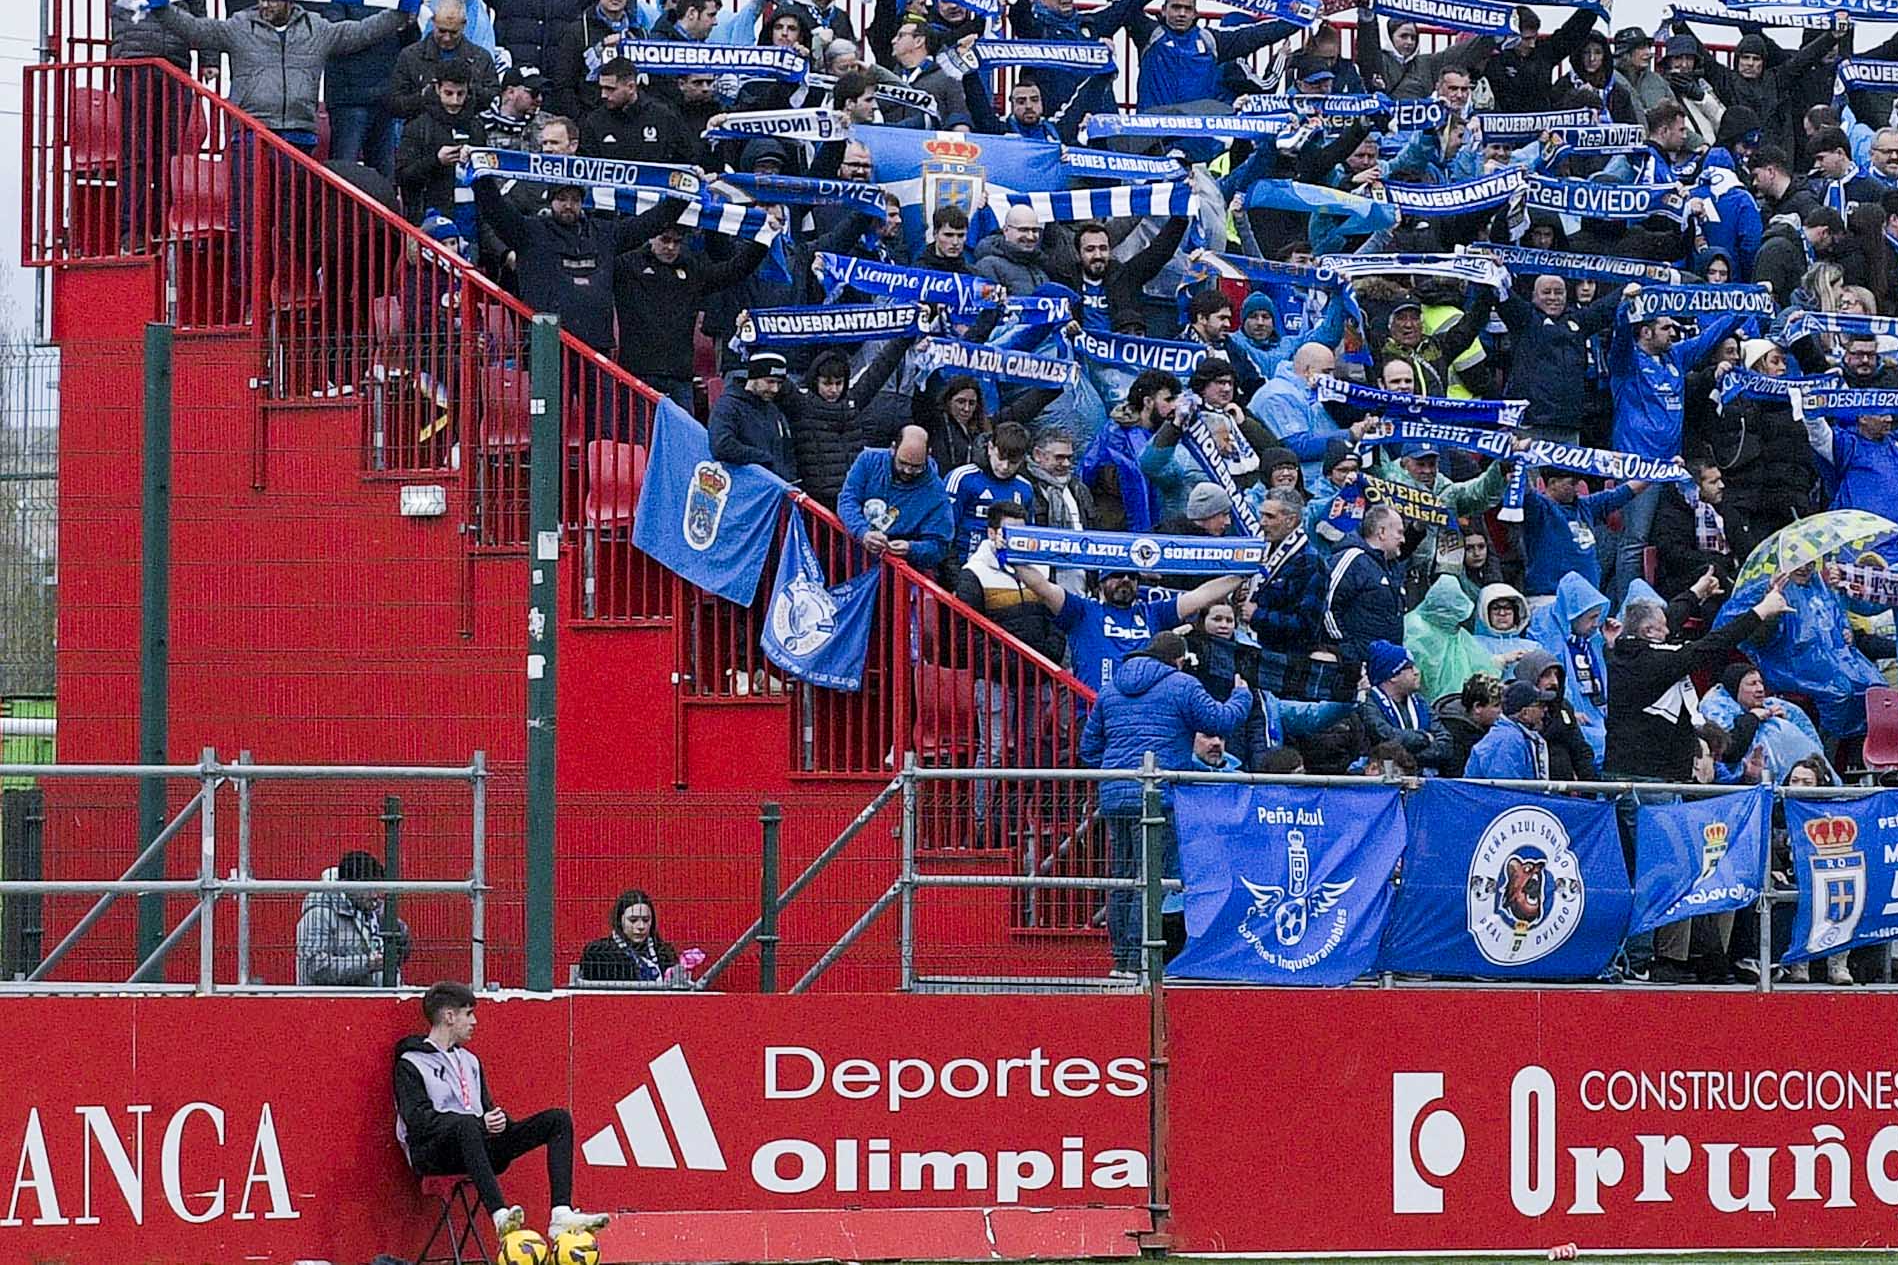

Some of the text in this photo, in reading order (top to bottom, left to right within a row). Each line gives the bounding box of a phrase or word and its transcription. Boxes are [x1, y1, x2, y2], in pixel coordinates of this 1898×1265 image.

[624, 44, 805, 72] INQUEBRANTABLES
[976, 41, 1110, 64] INQUEBRANTABLES
[1121, 116, 1291, 135] CAMPEONES CARBAYONES
[1396, 100, 1442, 125] IEDO
[1483, 110, 1592, 133] INQUEBRANTABLES
[1576, 128, 1606, 147] Real
[529, 152, 639, 185] Real OVIEDO
[1107, 156, 1182, 174] CARBAYONES
[818, 180, 889, 209] OVIED
[1391, 166, 1527, 208] INQUEBRANTABL
[1528, 176, 1651, 213] Real OVIEDO
[1635, 292, 1658, 313] YO
[1660, 291, 1684, 312] NO
[758, 308, 916, 334] INQUEBRANTABLES
[934, 341, 968, 366] PEÑA
[969, 350, 1003, 371] AZUL
[1073, 331, 1202, 374] Real OVIEDO
[1530, 441, 1593, 470] Real
[1192, 419, 1263, 538] INQUEBRANTA
[1039, 537, 1234, 561] PEÑA AZUL SOMIEDO
[1256, 805, 1324, 826] Peña Azul
[1483, 821, 1537, 864] PEÑA AZUL
[1478, 905, 1571, 947] REAL OVIEDO
[764, 1046, 1148, 1112] Deportes
[0, 1102, 300, 1227] ANCA
[751, 1136, 1149, 1204] Olimpia
